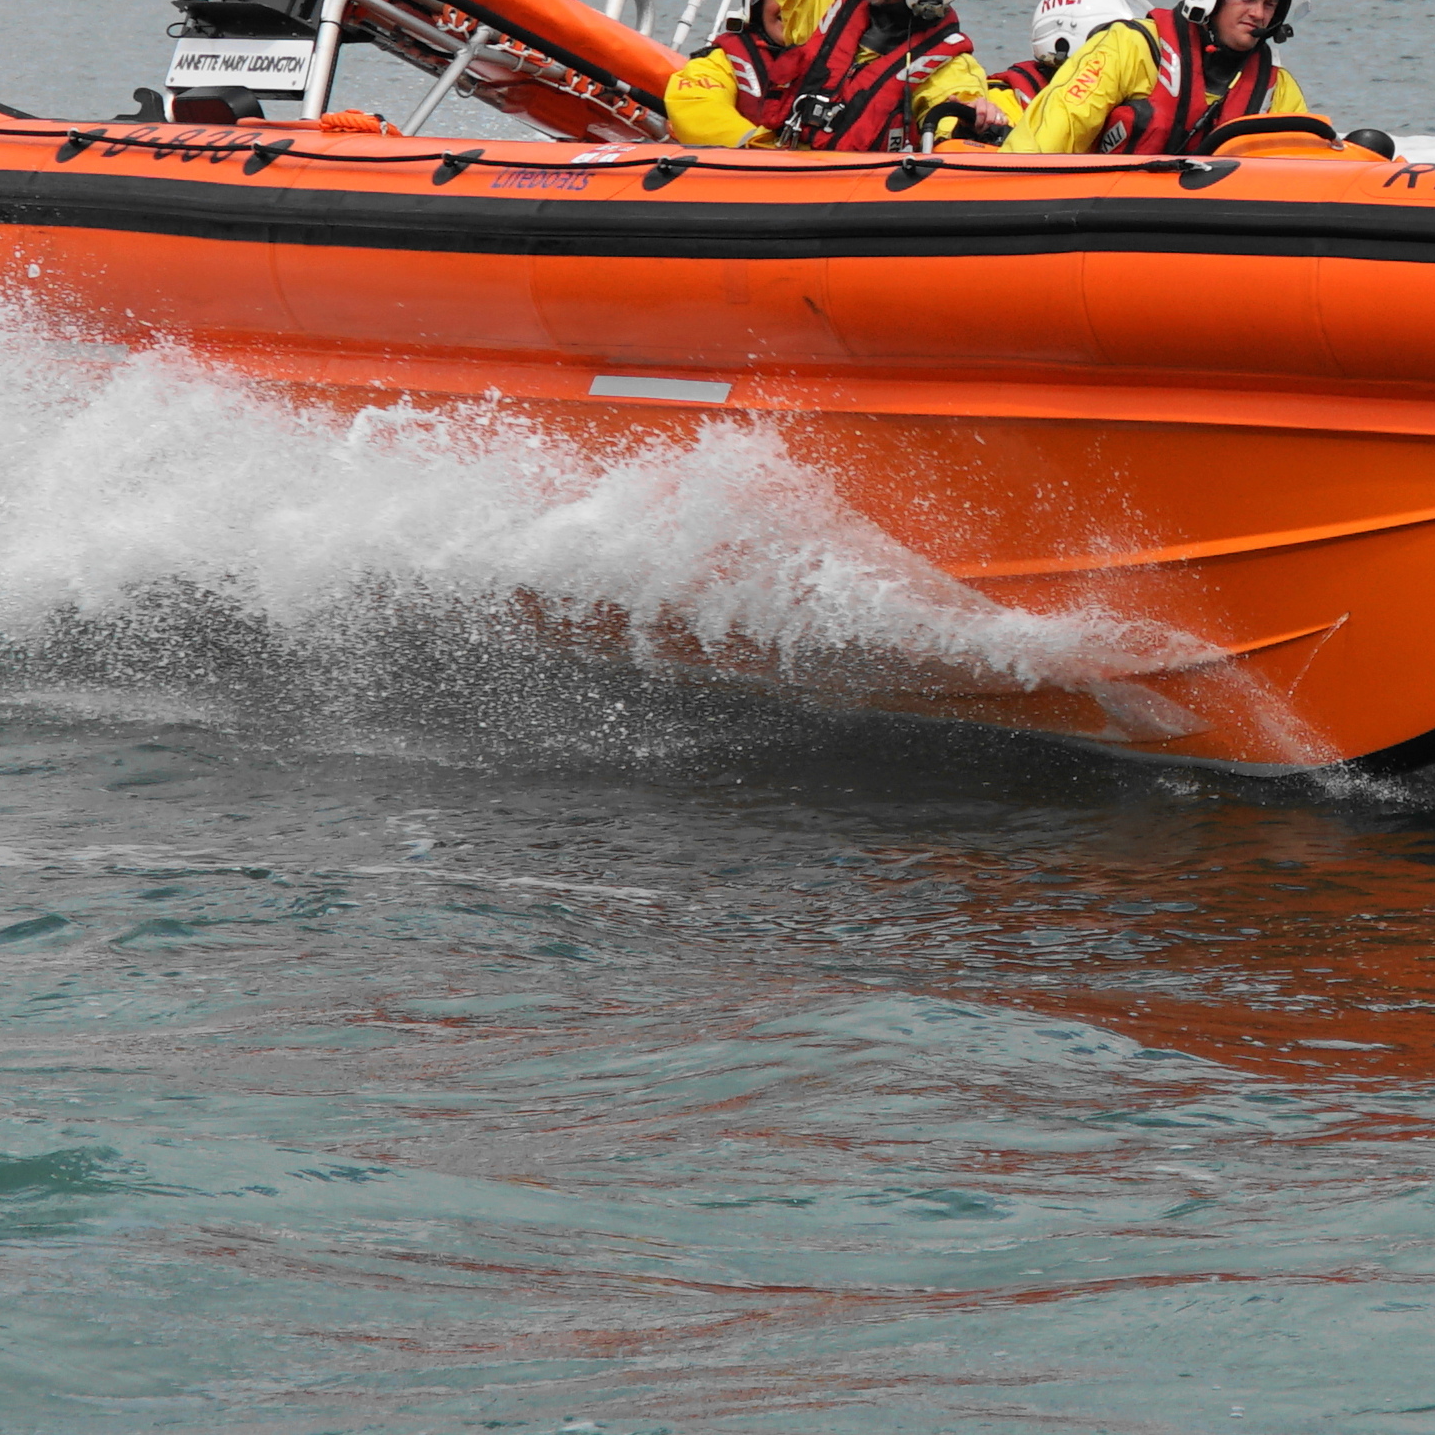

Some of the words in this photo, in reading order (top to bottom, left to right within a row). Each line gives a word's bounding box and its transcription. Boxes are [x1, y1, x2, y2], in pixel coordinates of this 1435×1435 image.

[175, 54, 221, 71] ANNETTE
[219, 54, 249, 72] MARY
[247, 55, 305, 73] LIDDINGTON
[1102, 126, 1123, 152] NLI
